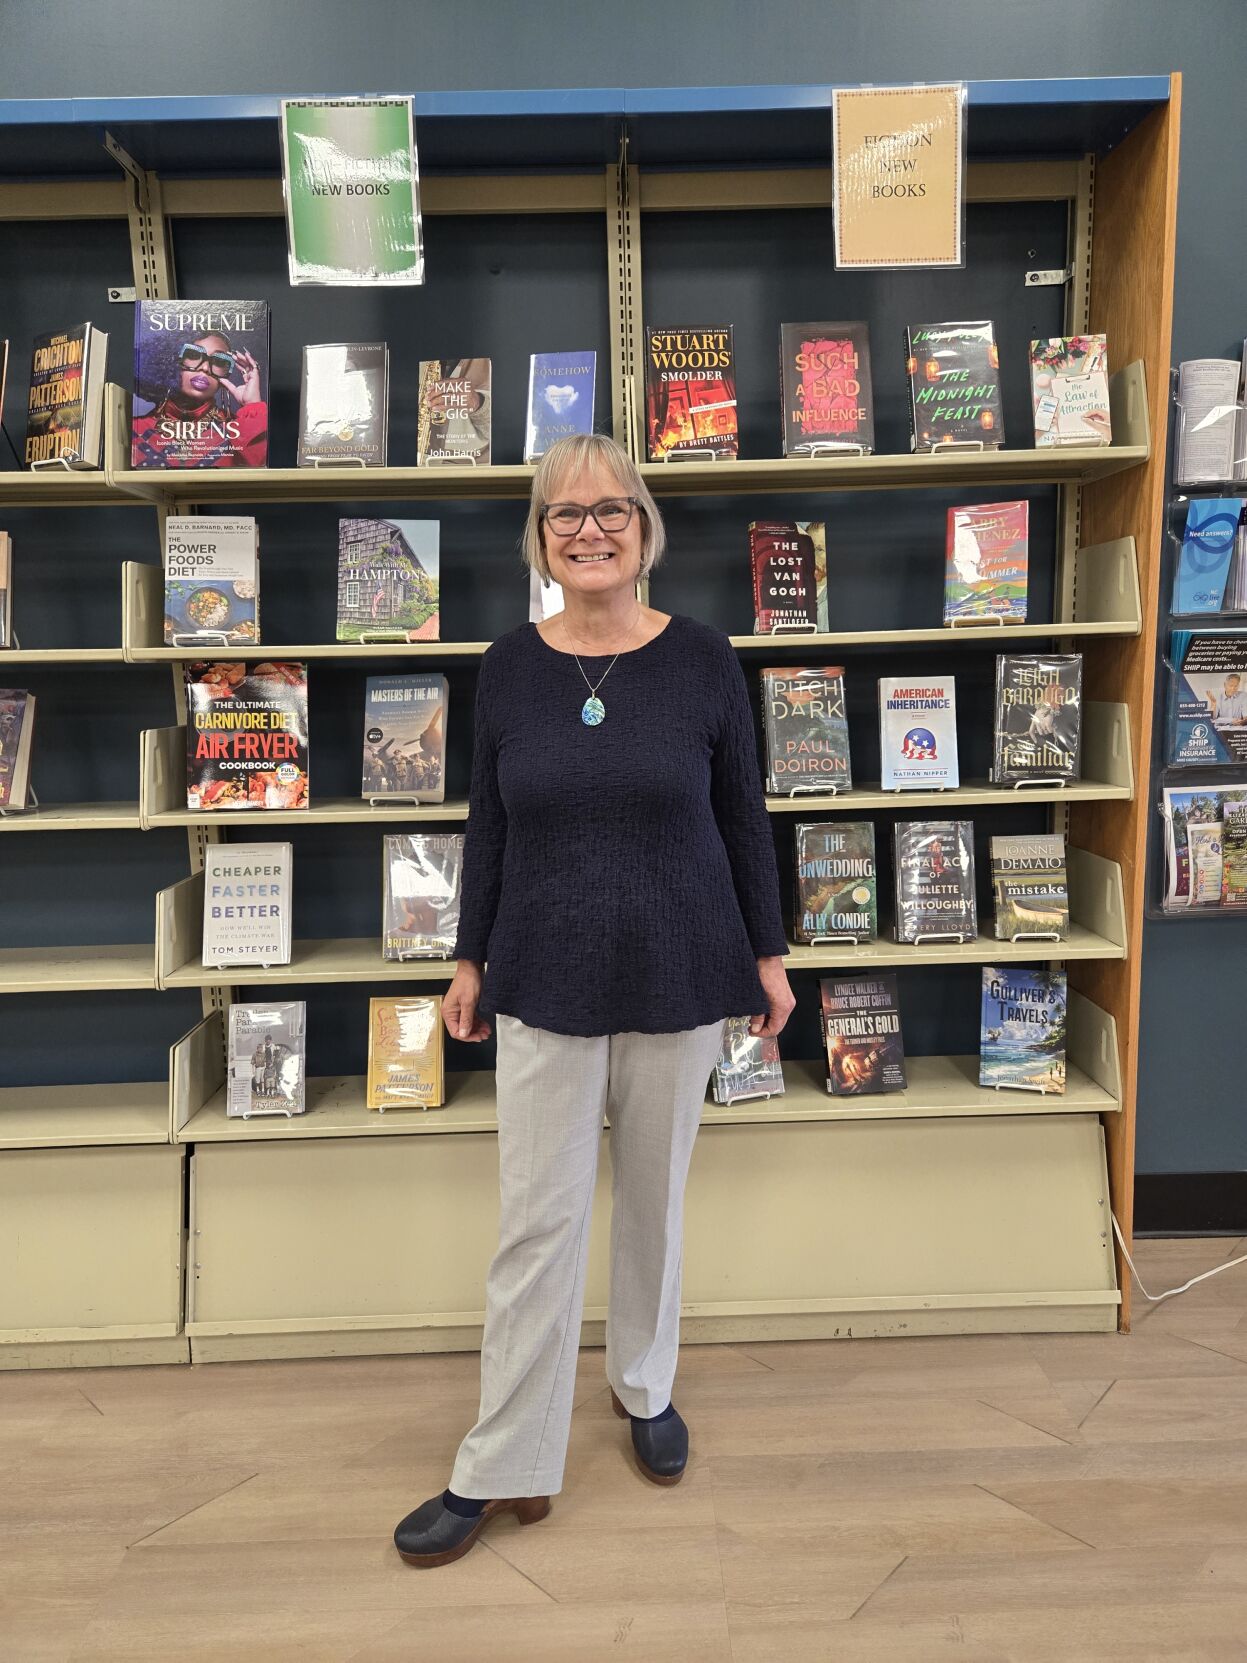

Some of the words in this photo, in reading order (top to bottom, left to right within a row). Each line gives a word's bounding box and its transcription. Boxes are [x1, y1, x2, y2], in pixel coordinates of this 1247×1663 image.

[864, 133, 933, 149] FICON
[880, 158, 918, 174] NEW
[312, 184, 342, 196] NEW
[346, 183, 390, 196] BOOKS
[872, 183, 927, 199] BOOKS
[149, 313, 255, 331] SUPREME
[651, 334, 728, 351] STUART
[33, 339, 84, 373] CRICHTON
[651, 351, 732, 369] WOODS'
[795, 352, 859, 372] SUCH
[535, 366, 592, 378] SOMEHOW
[661, 370, 723, 382] SMOLDER
[942, 369, 970, 382] THE
[29, 376, 84, 410] PATTERSON
[430, 381, 472, 393] "MAKE
[795, 384, 806, 396] A
[812, 379, 861, 398] BAD
[442, 394, 468, 407] THE
[916, 385, 997, 405] MIDNIGHT
[1064, 390, 1088, 403] Law
[931, 405, 982, 423] FEAST
[1060, 401, 1107, 416] Attraction
[792, 408, 867, 423] INFLUENCE
[160, 421, 241, 440] SIRENS
[544, 424, 576, 433] ANNE
[25, 429, 80, 463] ERUPTION
[689, 438, 707, 447] BRETT
[709, 434, 734, 444] BATTLES
[319, 445, 353, 454] BEYOND
[354, 444, 379, 452] GOLD
[428, 449, 451, 457] John
[453, 448, 481, 457] Harris
[1206, 530, 1233, 538] answers?
[168, 544, 217, 554] POWER
[773, 542, 799, 551] THE
[168, 555, 214, 565] FOODS
[769, 557, 803, 566] LOST
[168, 567, 197, 577] DIET
[350, 568, 428, 580] HAMPTONS
[774, 572, 800, 581] VAN
[769, 587, 806, 596] GOGH
[371, 689, 404, 703] MASTERS
[404, 688, 413, 701] OF
[414, 688, 426, 701] THE
[426, 687, 439, 700] AIR
[774, 680, 838, 698] PITCH
[893, 688, 944, 699] AMERICAN
[1002, 686, 1076, 706] BARDUGO
[214, 701, 233, 709] THE
[235, 701, 282, 709] ULTIMATE
[771, 699, 845, 720] DARK
[886, 699, 951, 710] INHERITANCE
[195, 712, 269, 729] CARNIVORE
[270, 712, 298, 729] DIET
[195, 732, 230, 759] AIR
[233, 732, 299, 759] FRYER
[786, 740, 836, 754] PAUL
[1179, 749, 1216, 757] INSURANCE
[219, 761, 276, 770] COOKBOOK
[774, 757, 847, 773] DOIRON
[433, 837, 463, 850] HOME
[823, 834, 846, 853] THE
[1005, 844, 1055, 860] JOANNE
[943, 856, 962, 867] AC
[1001, 857, 1062, 870] DEMAIO
[212, 866, 282, 877] CHEAPER
[799, 858, 873, 879] UNWEDDING
[211, 884, 281, 898] FASTER
[1007, 883, 1065, 895] mistake
[900, 899, 972, 910] WILLOUGHBY
[211, 904, 280, 919] BETTER
[802, 912, 827, 930] ALLY
[831, 912, 871, 929] CONDIE
[238, 945, 279, 953] STEYER
[387, 937, 428, 949] BRITTNEY
[830, 997, 849, 1010] BRUCE
[849, 995, 871, 1009] ROBERT
[997, 1001, 1048, 1024] TRAVELS
[827, 1016, 874, 1037] GENERAL'S
[875, 1015, 900, 1034] GOLD
